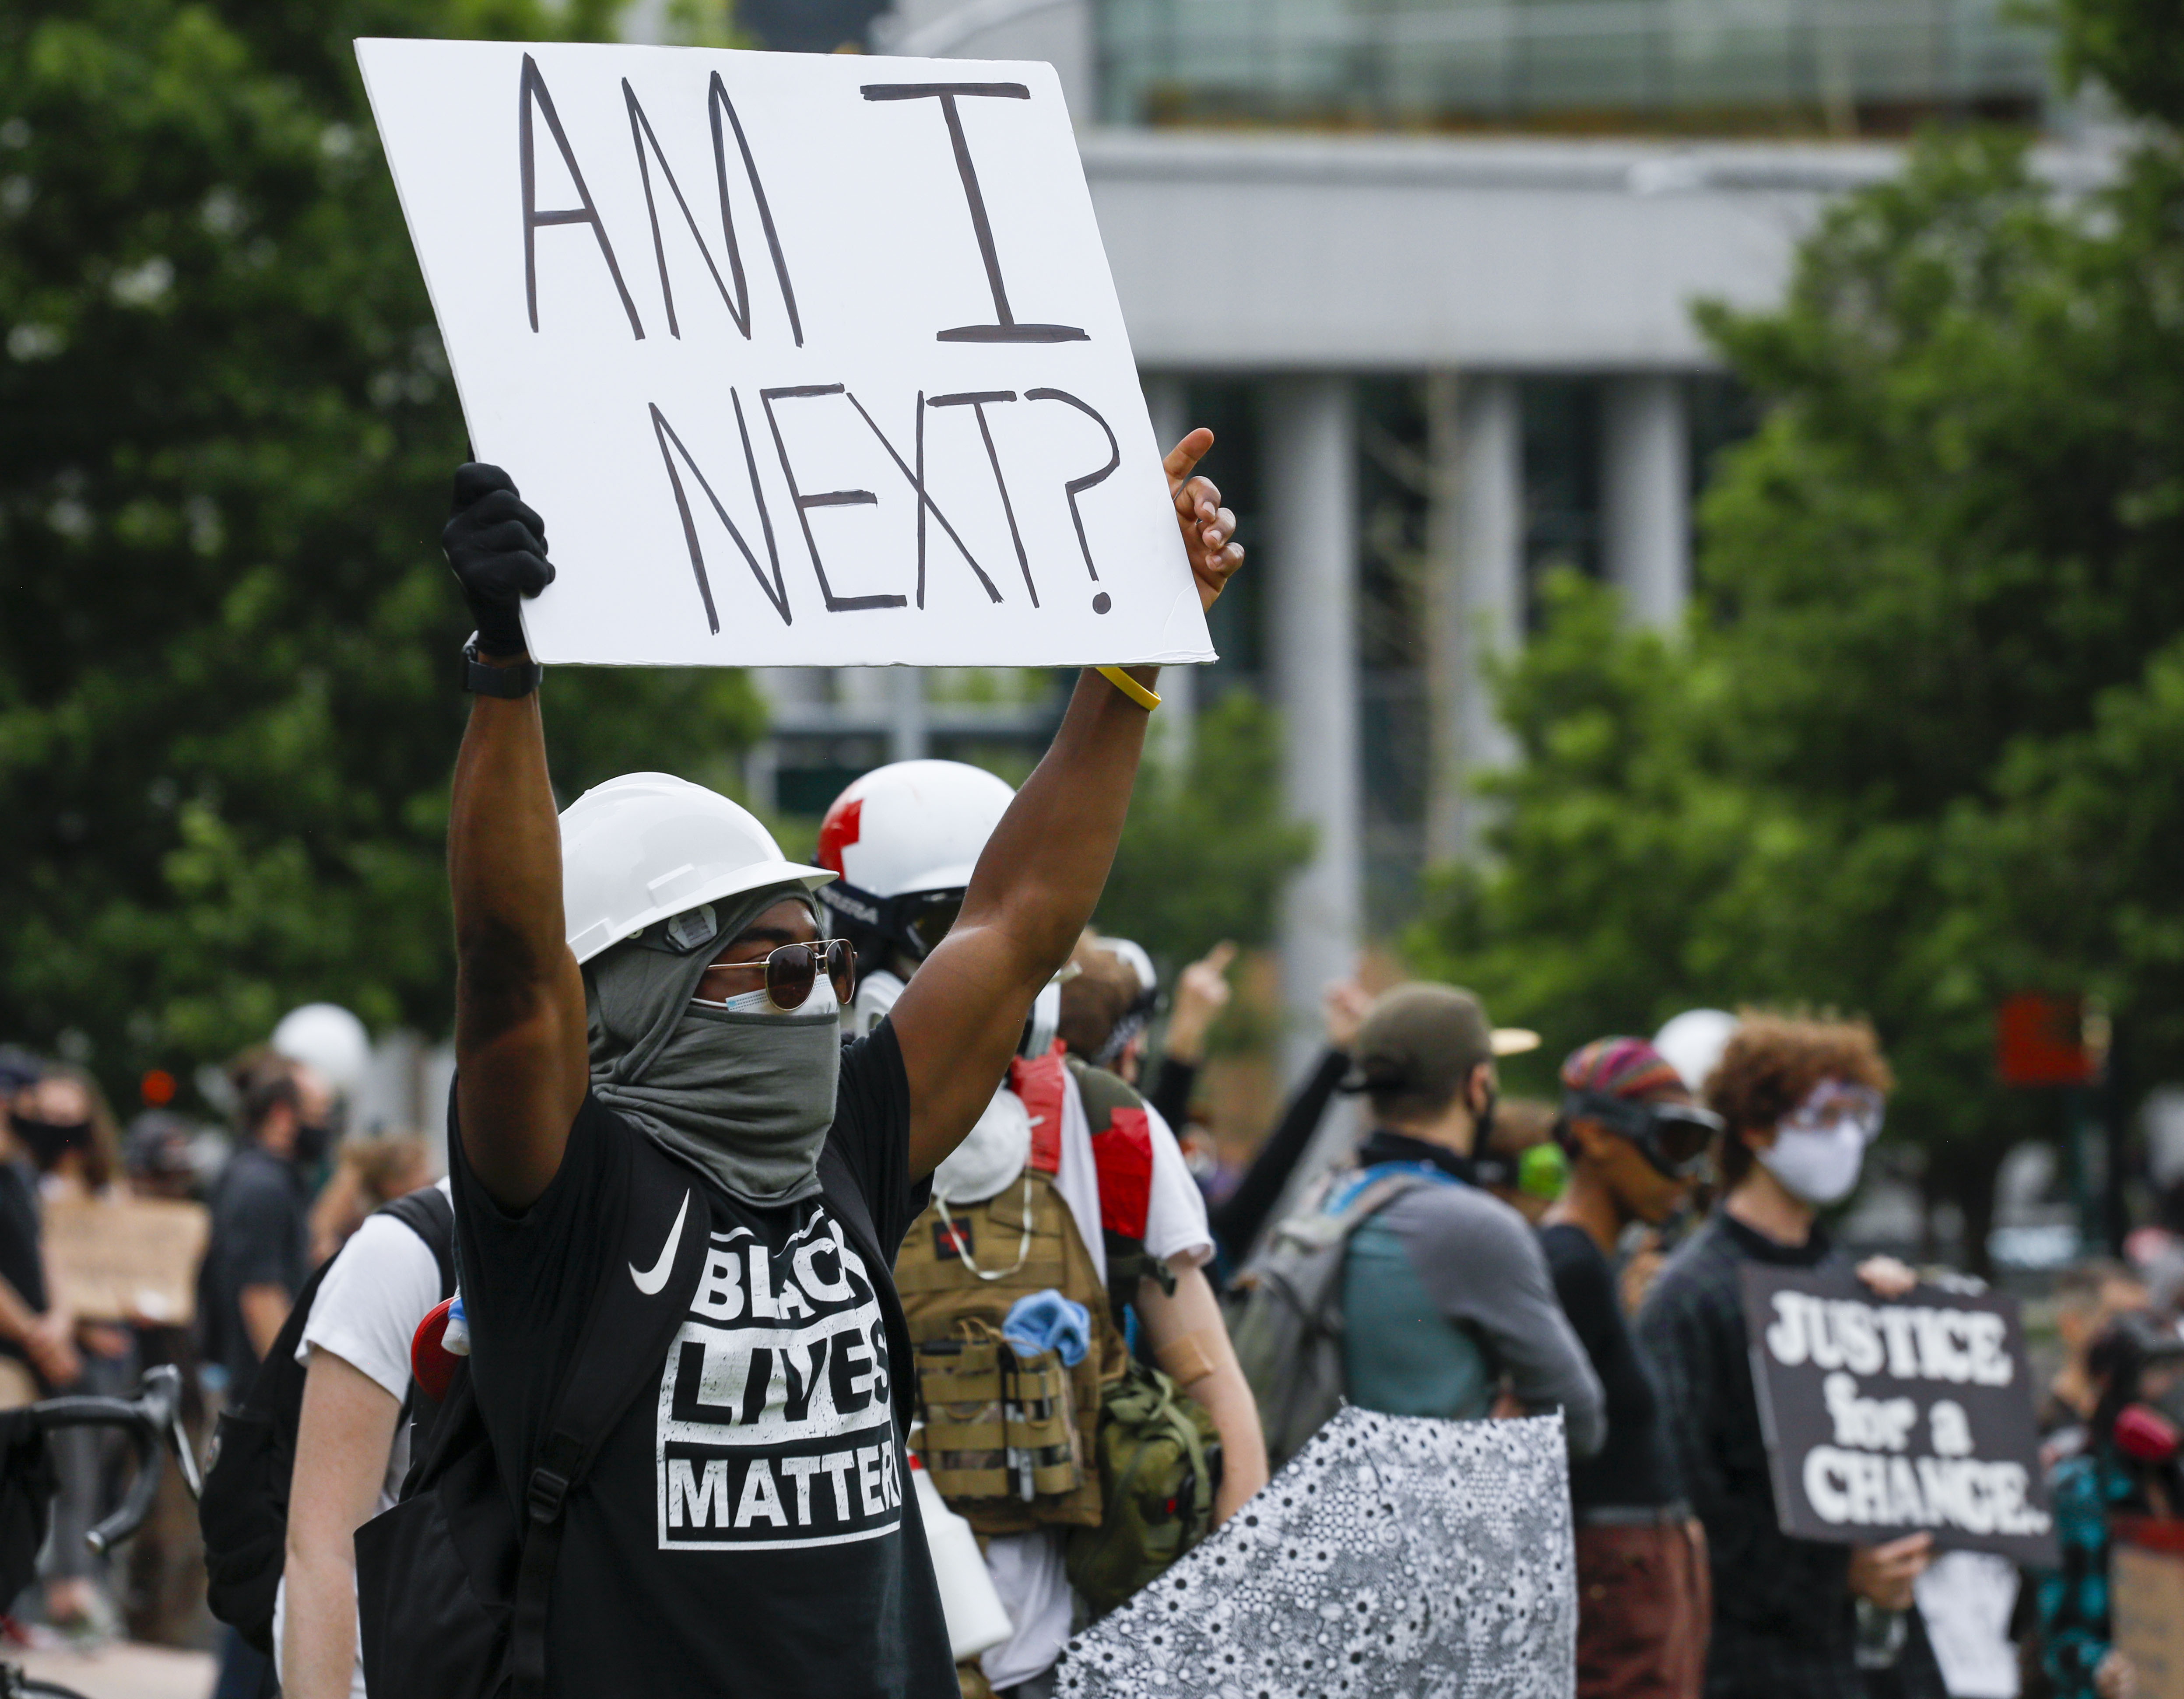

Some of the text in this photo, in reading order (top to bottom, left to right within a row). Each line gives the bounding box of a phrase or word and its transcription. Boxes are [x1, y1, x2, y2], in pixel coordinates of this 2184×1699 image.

[519, 52, 1092, 349] AM I
[648, 382, 1121, 636] NEXT?
[671, 1317, 891, 1426] LIVES
[1766, 1290, 2013, 1386] JUSTICE
[1823, 1372, 1974, 1456] for a
